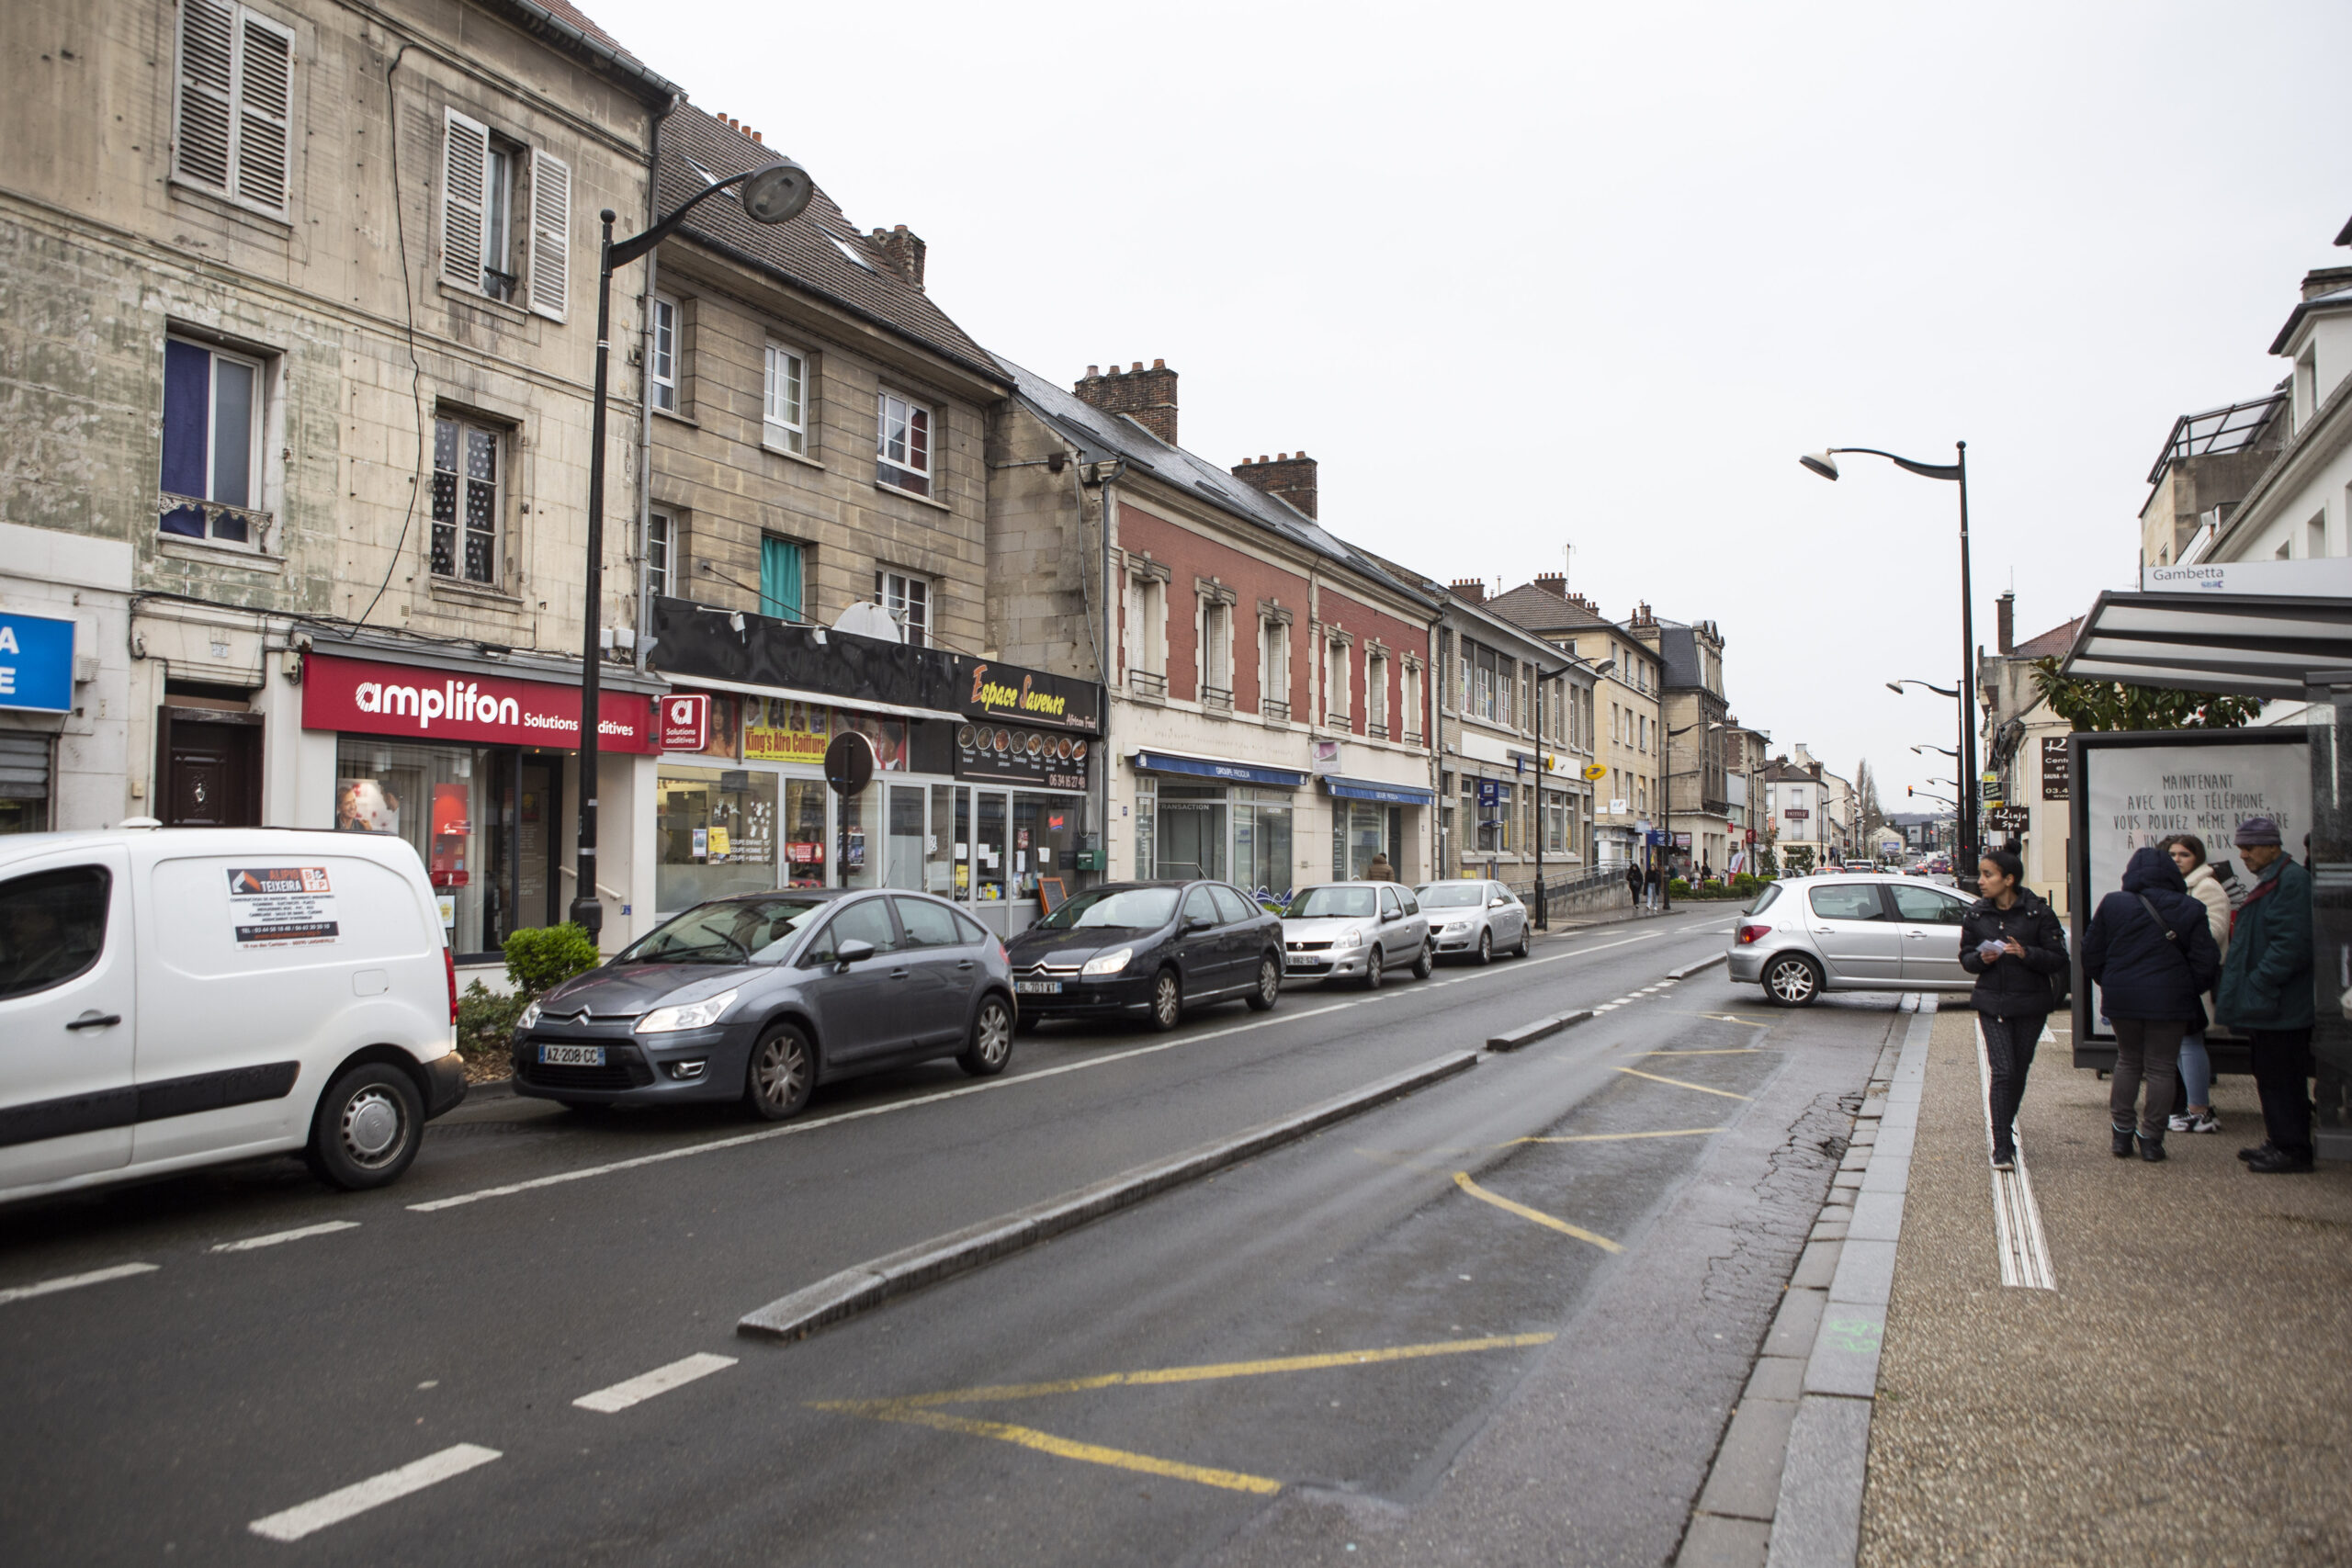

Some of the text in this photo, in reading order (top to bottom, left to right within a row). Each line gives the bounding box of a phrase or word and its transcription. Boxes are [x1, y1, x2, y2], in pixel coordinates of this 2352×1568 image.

[2154, 568, 2224, 581] Gambetta
[971, 664, 1065, 715] Espace Saveurs
[355, 680, 634, 737] amplifon Solutions ditives
[1067, 714, 1096, 728] African Food
[666, 728, 696, 737] Solutions
[666, 737, 696, 745] auditives
[745, 731, 826, 754] King's Afro Coiffure
[2162, 774, 2233, 790] MAINTENANT
[2128, 792, 2270, 811] AVEC VOTRE TÉLÉPHONE,
[1995, 808, 2028, 821] Kinja
[2114, 815, 2141, 829] VOUS
[2148, 815, 2188, 829] POUVEZ
[2198, 812, 2225, 829] MÊME
[2128, 832, 2135, 850] À
[261, 880, 302, 892] TEIXEIRA
